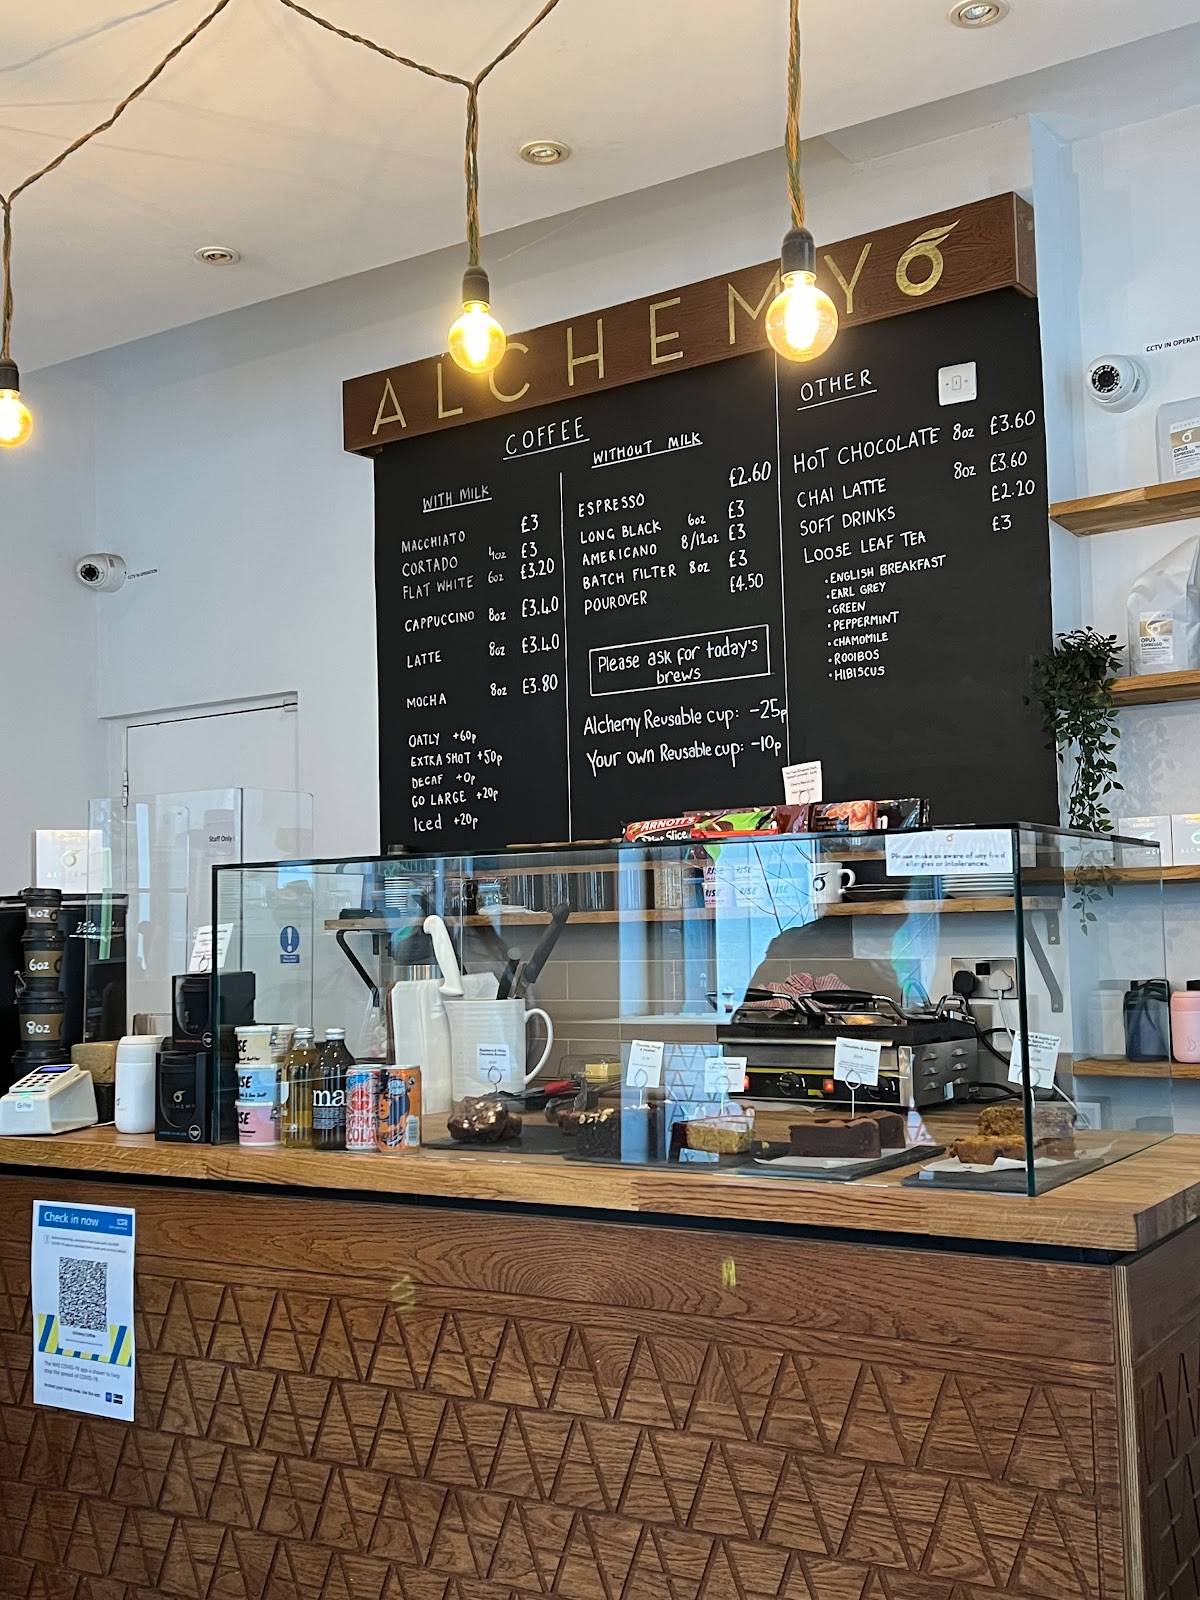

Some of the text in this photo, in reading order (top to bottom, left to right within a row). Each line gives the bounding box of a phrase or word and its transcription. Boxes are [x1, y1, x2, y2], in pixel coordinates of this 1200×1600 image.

[372, 243, 872, 435] ALCHEMY
[1146, 343, 1163, 352] CCTV
[800, 369, 872, 401] OTHER
[505, 417, 585, 455] COFFEE
[593, 432, 702, 465] WITHOUT MILK
[837, 427, 941, 465] CHOCOLATE
[952, 423, 975, 441] 8oz
[990, 410, 1036, 436] £3.60
[578, 461, 772, 517] ESPRESSO £2.60
[797, 451, 1028, 508] CHAI LATTE 8oz £3.60
[422, 484, 490, 510] WITH MILK
[800, 479, 1036, 536] SOFT DRINKS £2.20
[401, 514, 539, 553] MACCHIATO £3
[580, 500, 745, 544] LONG BLACK 6oz £3
[582, 523, 747, 566] AMERICANO 8/12oz £3
[803, 515, 1012, 564] LOOSE LEAF TEA £3
[402, 542, 538, 577] CORTADO 4oz £3
[582, 549, 748, 590] BATCH FILTER 8oz £3
[829, 555, 947, 584] ENGLISH BREAKFAST
[402, 558, 555, 599] FLAT WHITE 6oz £3.20
[584, 573, 764, 616] POUROVER £4.50
[830, 582, 886, 599] EARL GREY
[404, 596, 559, 632] CAPPUCCINO 8oz £3.40
[832, 601, 866, 615] GREEN
[832, 611, 900, 632] PEPPERMINT
[407, 633, 560, 668] LATTE 8oz £3.40
[598, 635, 759, 673] Please ask for today's
[832, 632, 889, 647] CHAMOMILE
[834, 649, 880, 665] ROOIBOS
[656, 667, 701, 685] brews
[834, 666, 885, 681] HIBISCUS
[406, 674, 559, 709] MOCHA 8oz £3.80
[583, 713, 641, 738] Alchemy
[643, 706, 702, 730] Reusable
[706, 708, 740, 730] cup:
[408, 730, 477, 748] OATLY +60p
[410, 749, 503, 767] EXTRA SHOT +50p
[586, 750, 622, 778] Your
[660, 740, 712, 763] Reusable
[715, 741, 745, 768] cup:
[411, 772, 476, 789] DECAF +0p
[411, 787, 499, 808] GO LARGE +20p
[413, 812, 478, 832] Iced +20p
[666, 830, 689, 841] Slice
[28, 958, 50, 971] 6oz
[25, 1020, 51, 1034] 8oz
[313, 1089, 347, 1107] ma
[347, 1128, 377, 1143] COLA
[44, 1211, 69, 1224] Check
[71, 1214, 79, 1224] in
[80, 1217, 100, 1227] now
